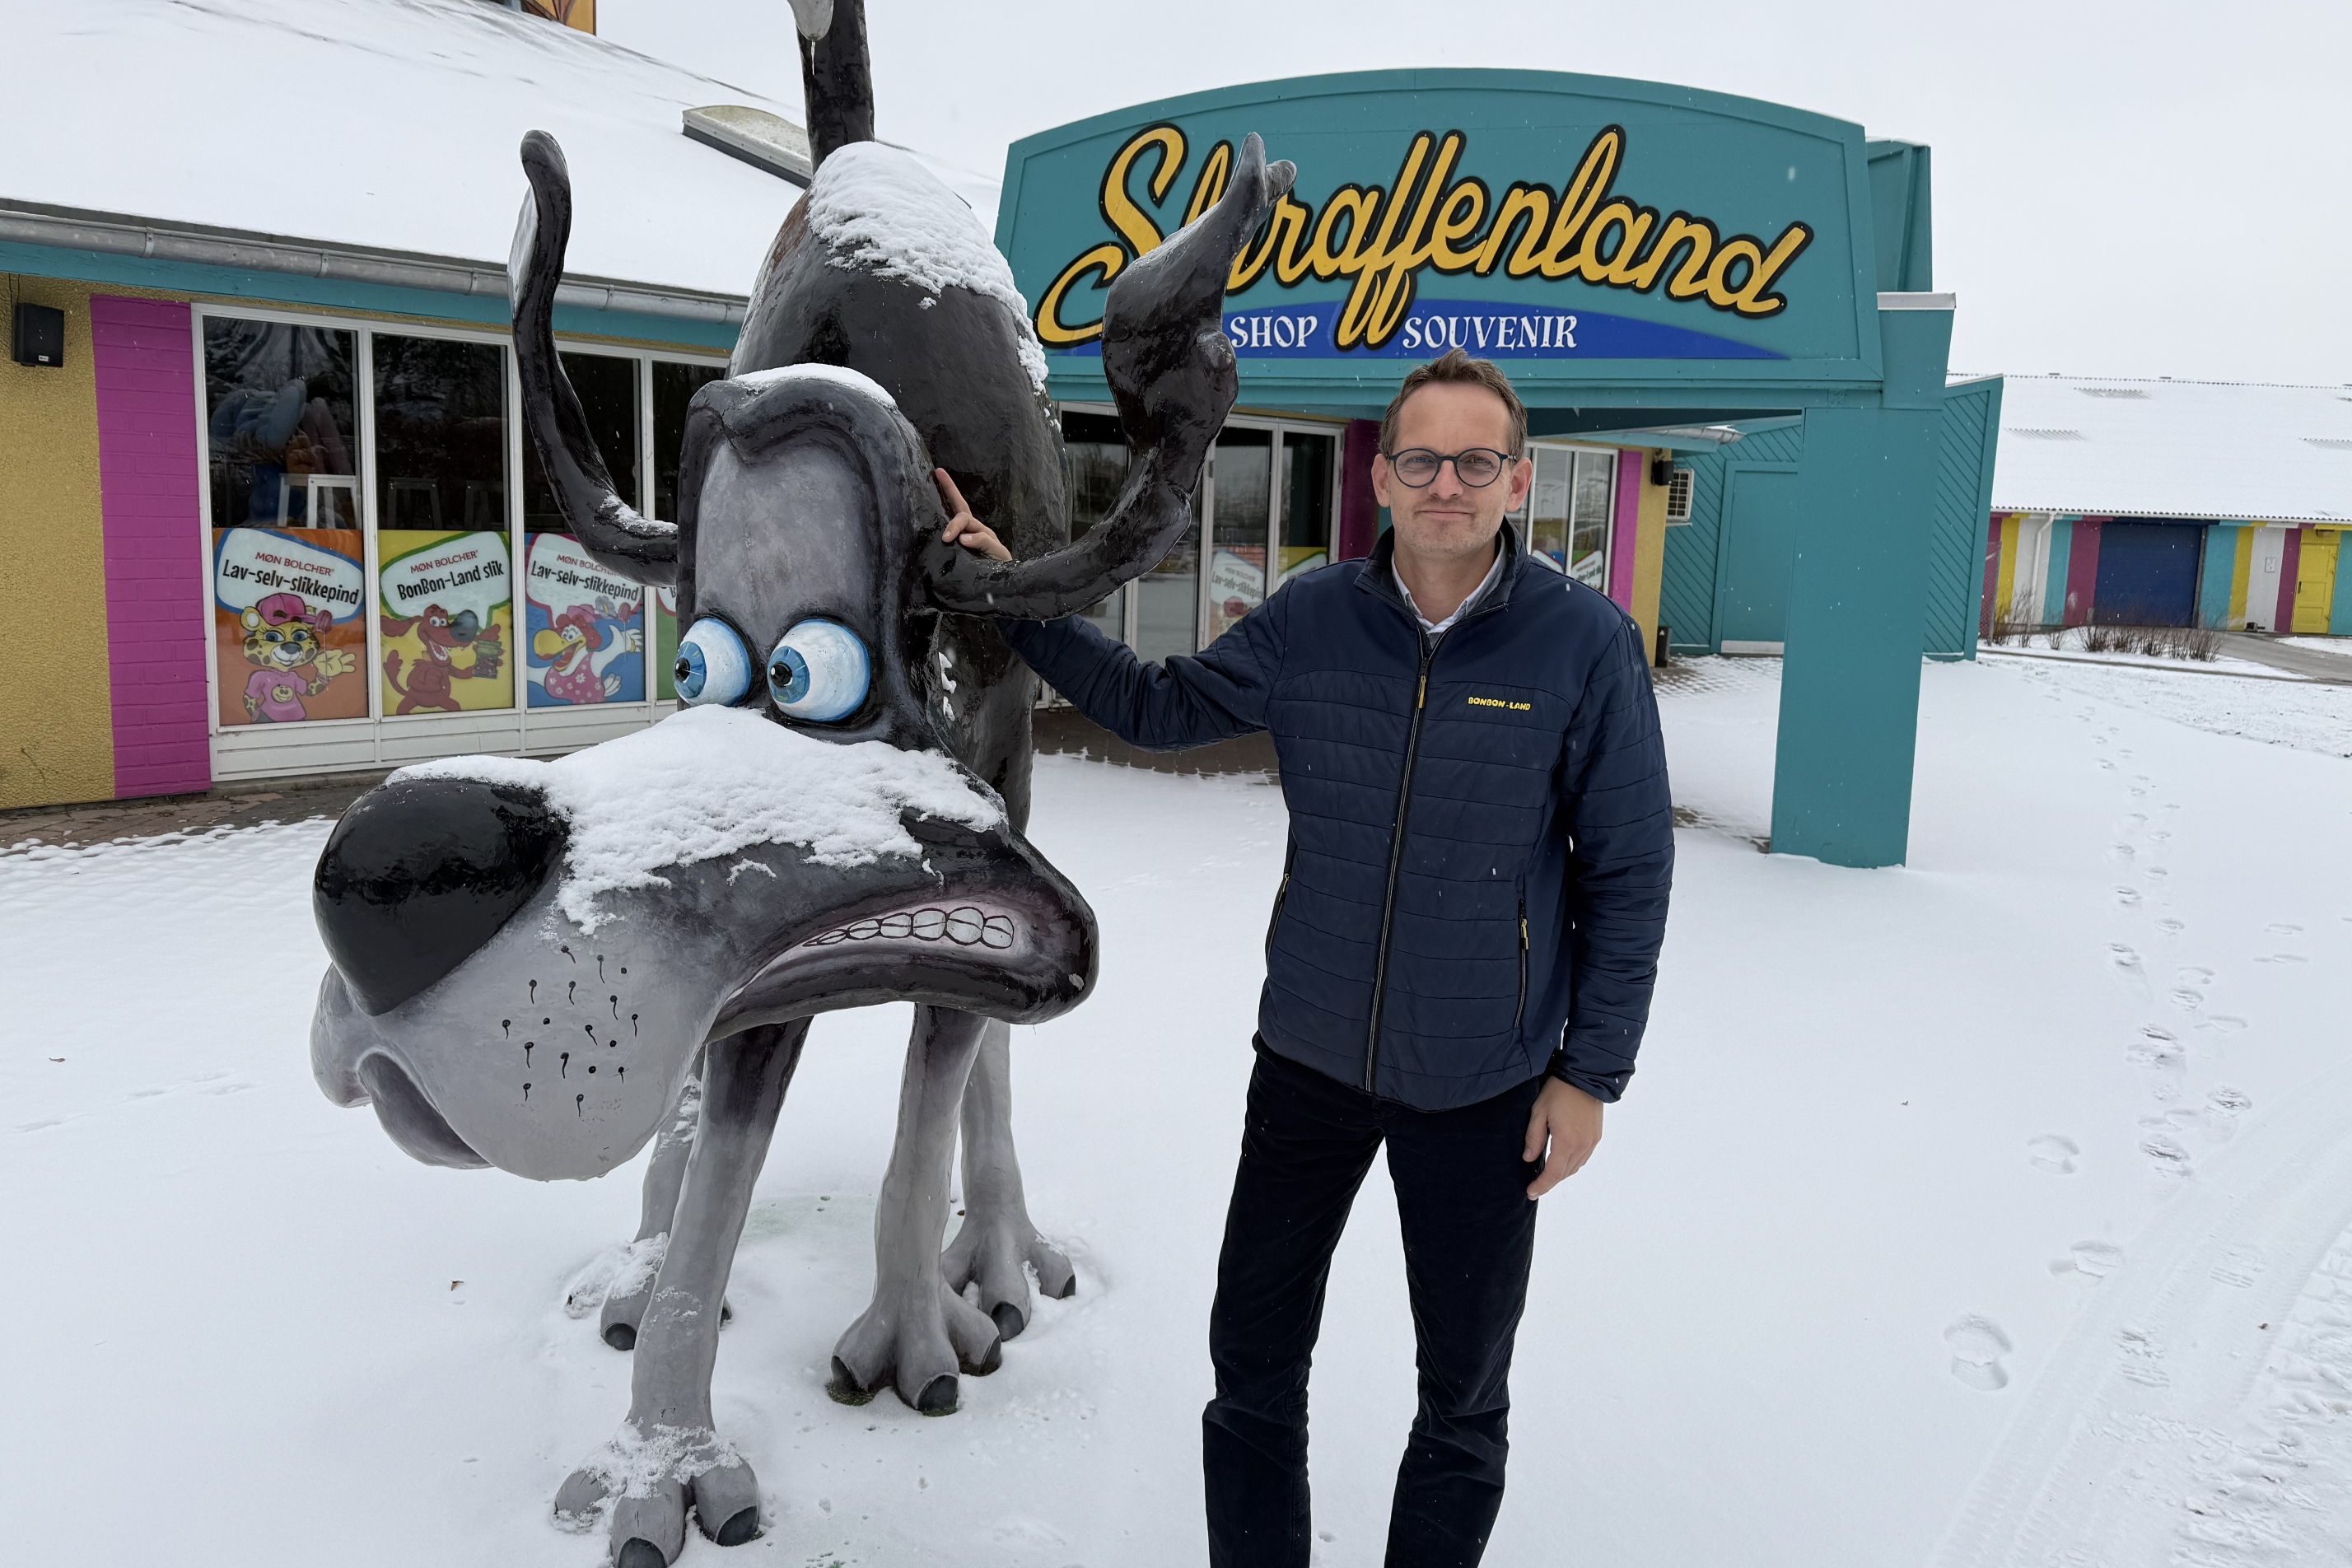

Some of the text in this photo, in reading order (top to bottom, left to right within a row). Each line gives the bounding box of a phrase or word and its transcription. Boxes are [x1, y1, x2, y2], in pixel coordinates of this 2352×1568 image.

[1035, 124, 1813, 351] Slraffenland
[1230, 315, 1578, 348] SHOP SOUVENIR
[254, 551, 332, 576] MØN BOLCHER
[397, 560, 504, 600] BonBon-Land slik
[410, 550, 477, 574] MØN BOLCHER
[557, 553, 613, 576] MØN BOLCH
[222, 558, 359, 605] Lav-selv-slikkepind
[530, 560, 638, 601] Lav-selv-slikkepind
